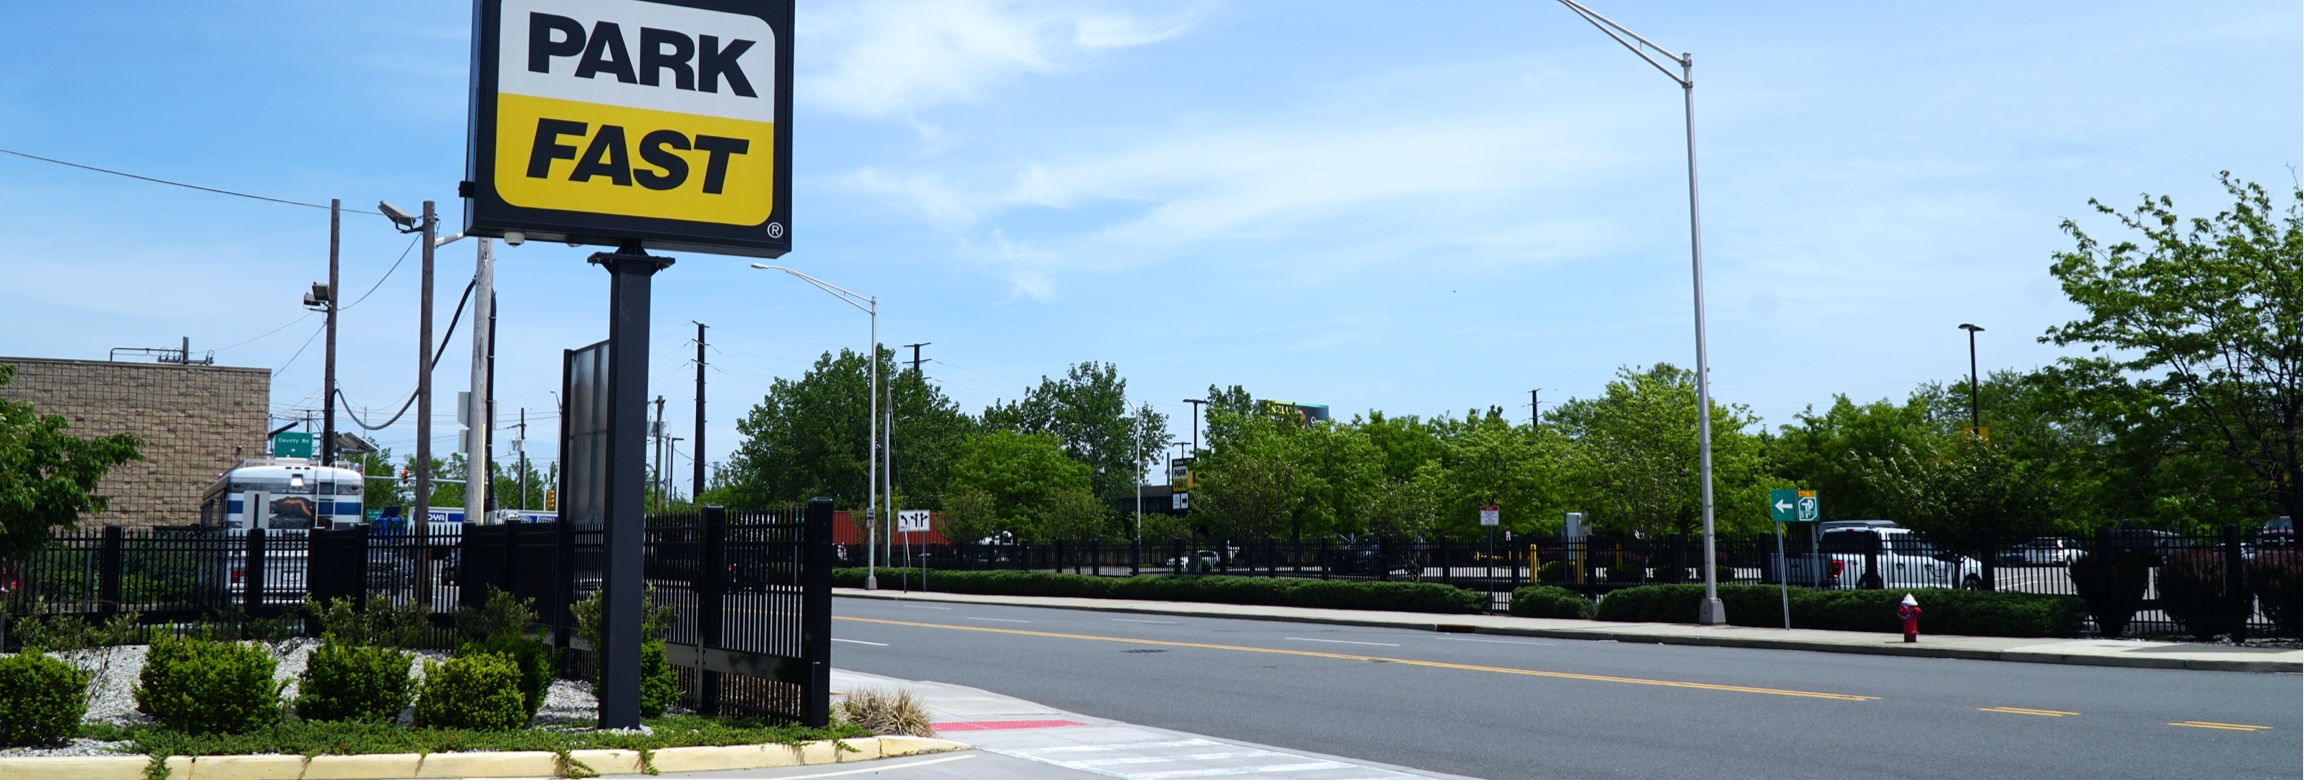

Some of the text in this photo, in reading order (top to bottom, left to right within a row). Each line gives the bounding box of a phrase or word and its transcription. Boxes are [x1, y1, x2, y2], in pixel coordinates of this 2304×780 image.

[527, 11, 758, 98] PARK
[526, 118, 750, 195] FAST
[1174, 469, 1187, 477] PARK
[1174, 480, 1187, 488] FAS
